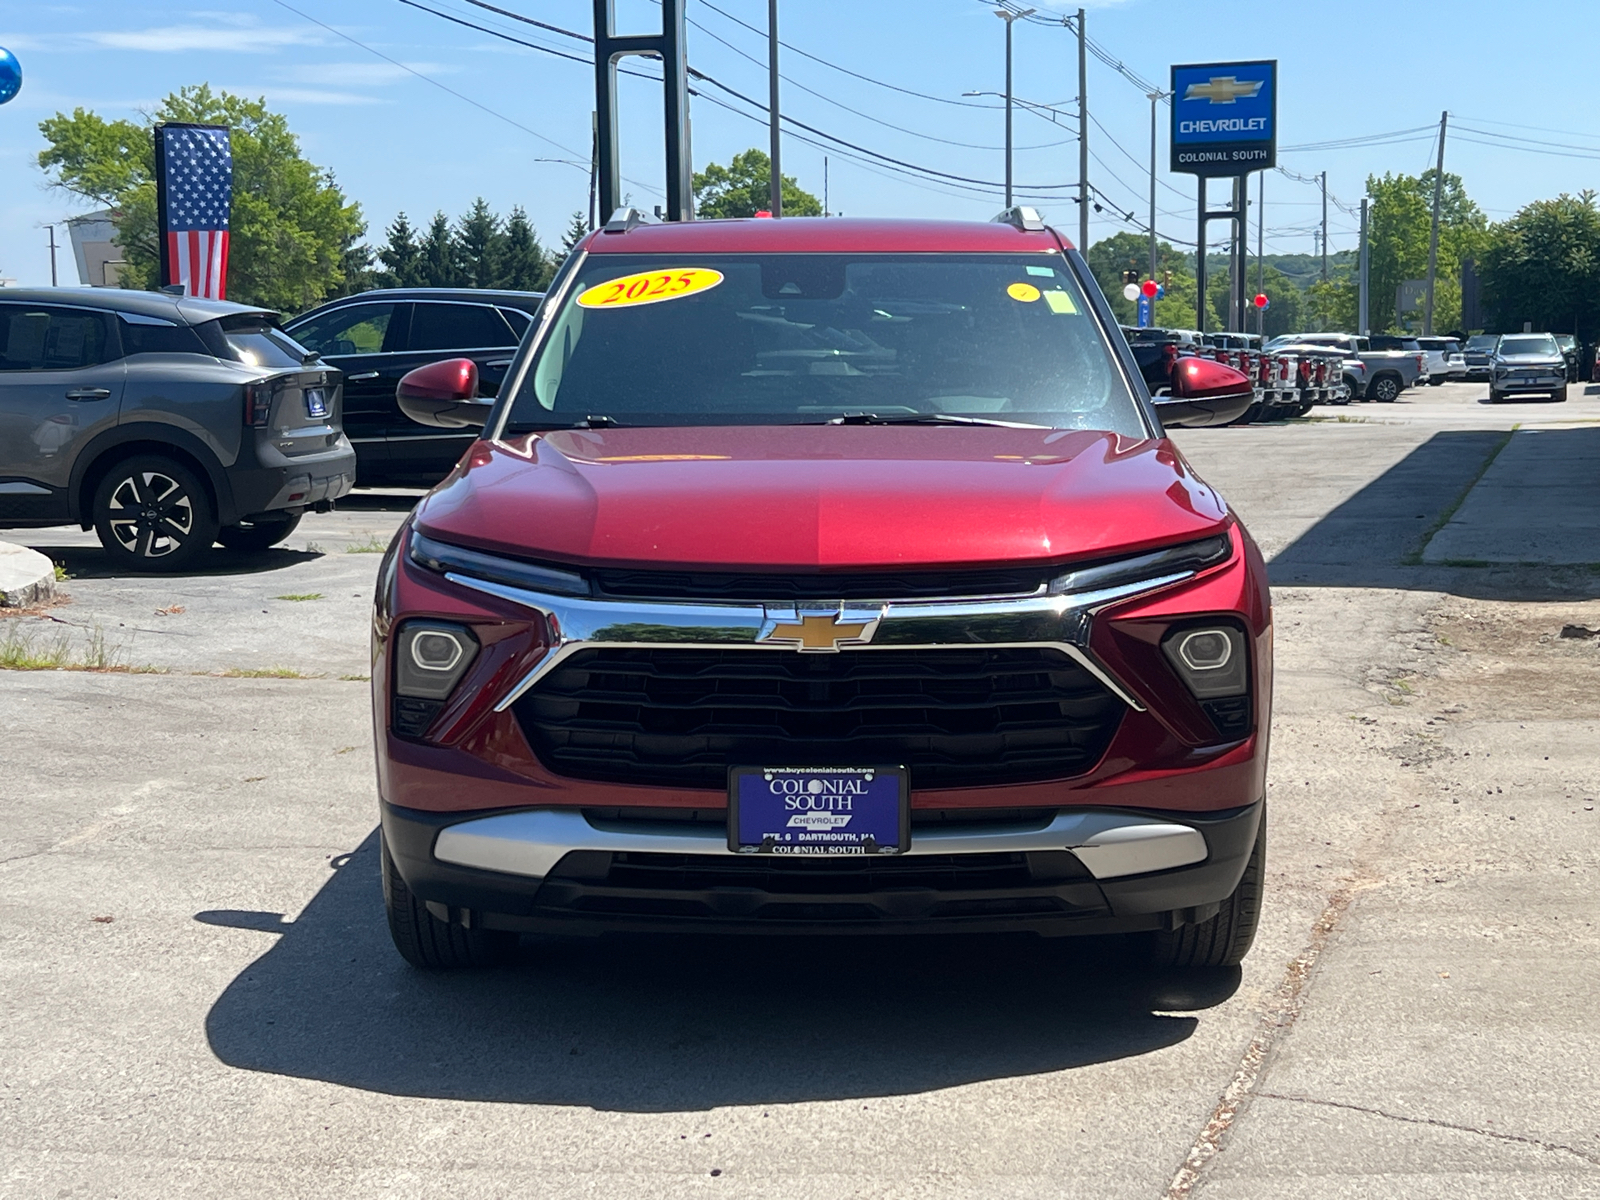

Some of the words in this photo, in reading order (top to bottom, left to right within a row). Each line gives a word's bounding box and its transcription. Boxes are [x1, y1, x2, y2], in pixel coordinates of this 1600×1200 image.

[1180, 117, 1267, 133] CHEVROLET
[1179, 152, 1229, 163] COLONIAL
[1232, 150, 1267, 160] SOUTH
[600, 272, 697, 304] 2025
[769, 779, 868, 795] COLONIAL
[785, 795, 853, 810] SOUTH
[793, 817, 846, 825] CHEVROLET
[785, 833, 792, 841] 6
[798, 833, 859, 842] DARTMOUTH,
[772, 846, 828, 854] COLONIAL
[828, 846, 865, 854] SOUTH
